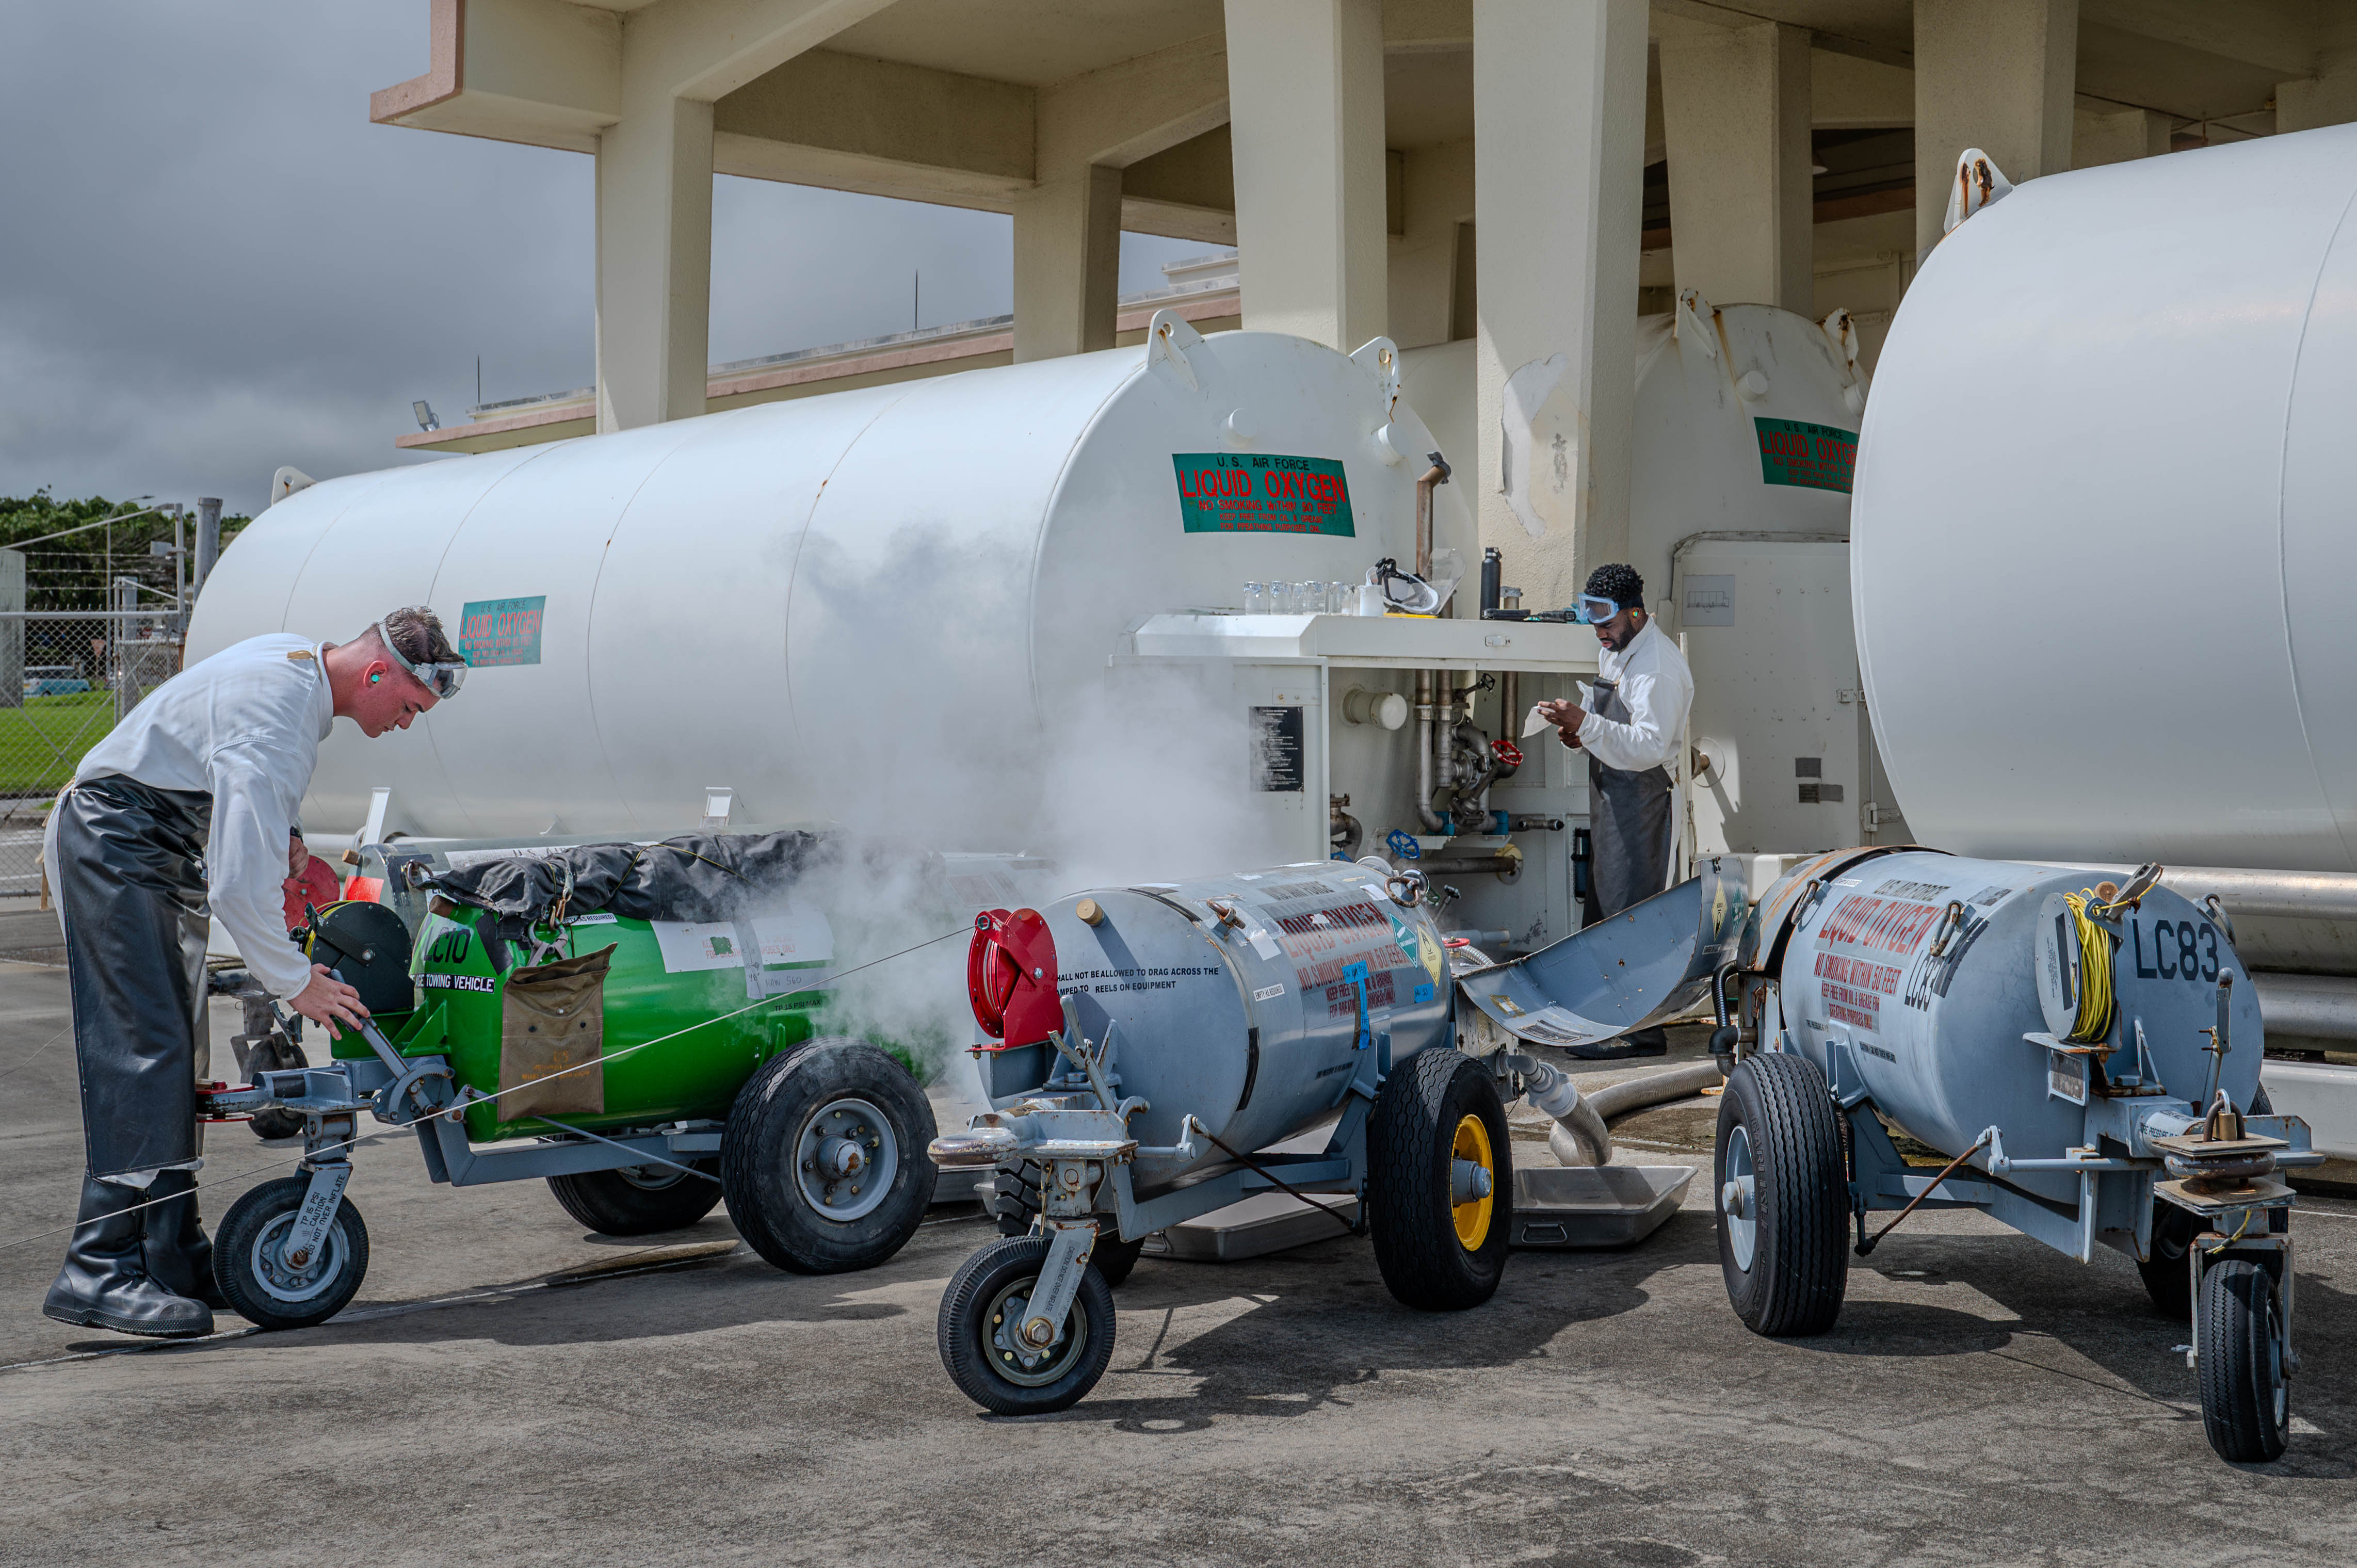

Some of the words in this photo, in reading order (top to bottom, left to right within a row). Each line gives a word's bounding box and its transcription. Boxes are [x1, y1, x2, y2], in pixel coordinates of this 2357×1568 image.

[1807, 425, 1819, 435] AIR
[1821, 428, 1844, 440] FORCE
[1760, 430, 1809, 457] LIQUID
[1816, 437, 1857, 467] OXYGE
[1252, 457, 1269, 468] AIR
[1274, 458, 1310, 471] FORCE
[1180, 470, 1252, 498] LIQUID
[1265, 471, 1346, 503] OXYGEN
[1199, 500, 1214, 511] NO
[1219, 499, 1262, 510] SMOKING
[1266, 500, 1296, 512] WITHIN
[1302, 502, 1313, 513] 50
[1317, 503, 1337, 515] FEET
[1239, 513, 1255, 521] FREE
[1301, 515, 1323, 524] GREASE
[496, 602, 505, 611] AIR
[508, 600, 526, 611] FORCE
[460, 613, 493, 639] LIQUID
[498, 609, 542, 637] OXYGEN
[1906, 884, 1951, 901] FORCE
[1321, 901, 1394, 945] OXYGEN
[1819, 895, 1882, 949] LIQUID
[1863, 901, 1946, 955] OXYGEN
[705, 950, 718, 960] FOR
[2132, 918, 2219, 982] LC83
[414, 974, 424, 987] AGE
[426, 974, 451, 988] TOWING
[454, 975, 494, 992] VEHICLE
[786, 976, 801, 986] 560
[1057, 971, 1073, 981] HALL
[1101, 969, 1134, 978] ALLOWED
[1297, 966, 1313, 991] NO
[1814, 952, 1825, 976] NO
[1823, 953, 1851, 983] SMOKING
[1849, 960, 1874, 989] WITHIN
[1871, 965, 1884, 992] 50
[1881, 967, 1902, 995] FEET
[1904, 950, 1942, 1012] LC83
[1057, 986, 1078, 996] AMPED
[1095, 984, 1118, 993] REELS
[1120, 982, 1130, 991] ON
[1132, 981, 1176, 991] EQUIPMENT
[1326, 985, 1338, 1001] KEEP
[1338, 983, 1350, 998] FREE
[1821, 981, 1830, 998] KEEP
[1830, 983, 1838, 1000] FREE
[1839, 986, 1848, 1004] FROM
[1859, 992, 1872, 1010] GREASE
[806, 999, 821, 1007] MAX
[1330, 1003, 1338, 1020] FOR
[1339, 999, 1355, 1016] BREATH
[1829, 1003, 1847, 1021] BREATHING
[1847, 1008, 1864, 1027] PURPOSES
[1864, 1013, 1872, 1030] ONLY
[1751, 1118, 1769, 1239] CARLISLE
[301, 1215, 309, 1225] TP
[306, 1206, 314, 1215] 15
[310, 1191, 320, 1205] PSI
[308, 1243, 316, 1255] DO
[313, 1226, 323, 1242] NOT
[319, 1206, 332, 1225] OVER
[328, 1174, 345, 1204] INFLATE
[310, 1197, 327, 1226] CAUTION
